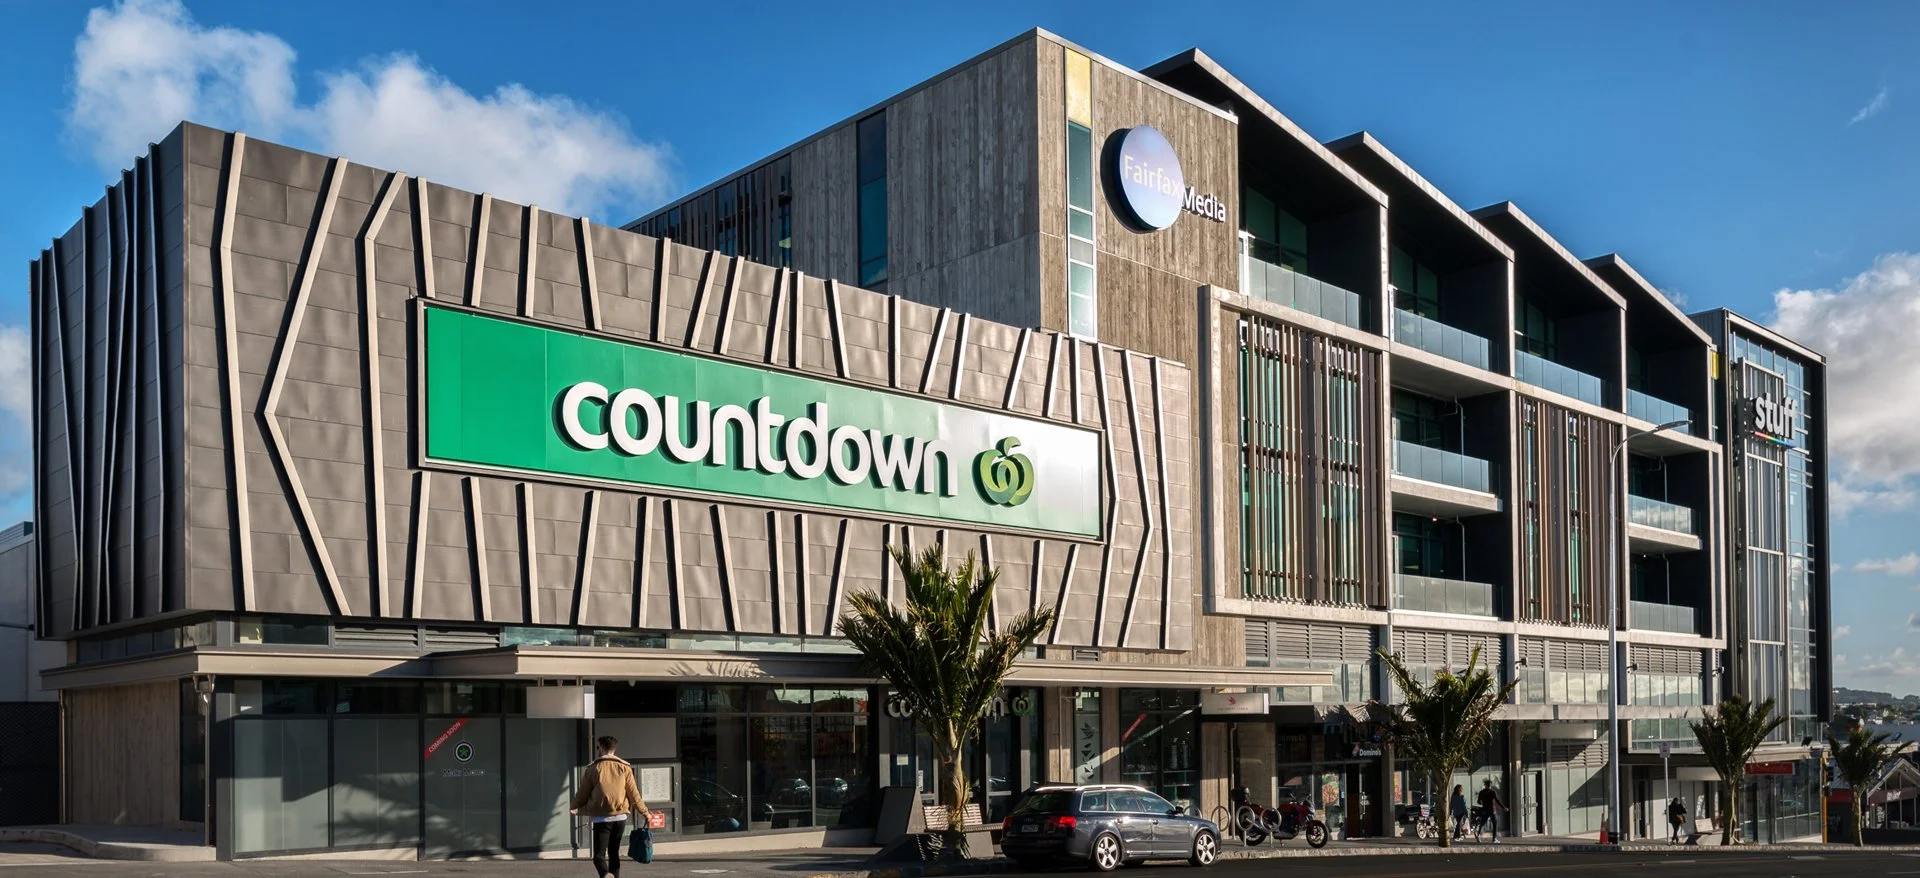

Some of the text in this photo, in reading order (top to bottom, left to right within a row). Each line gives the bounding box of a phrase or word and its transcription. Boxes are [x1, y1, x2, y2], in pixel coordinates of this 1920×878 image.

[1124, 155, 1226, 223] Fairfax Media
[562, 382, 958, 497] countdown
[1755, 392, 1798, 440] stuff
[428, 721, 461, 753] COMING SOON
[1359, 748, 1382, 757] Domino's
